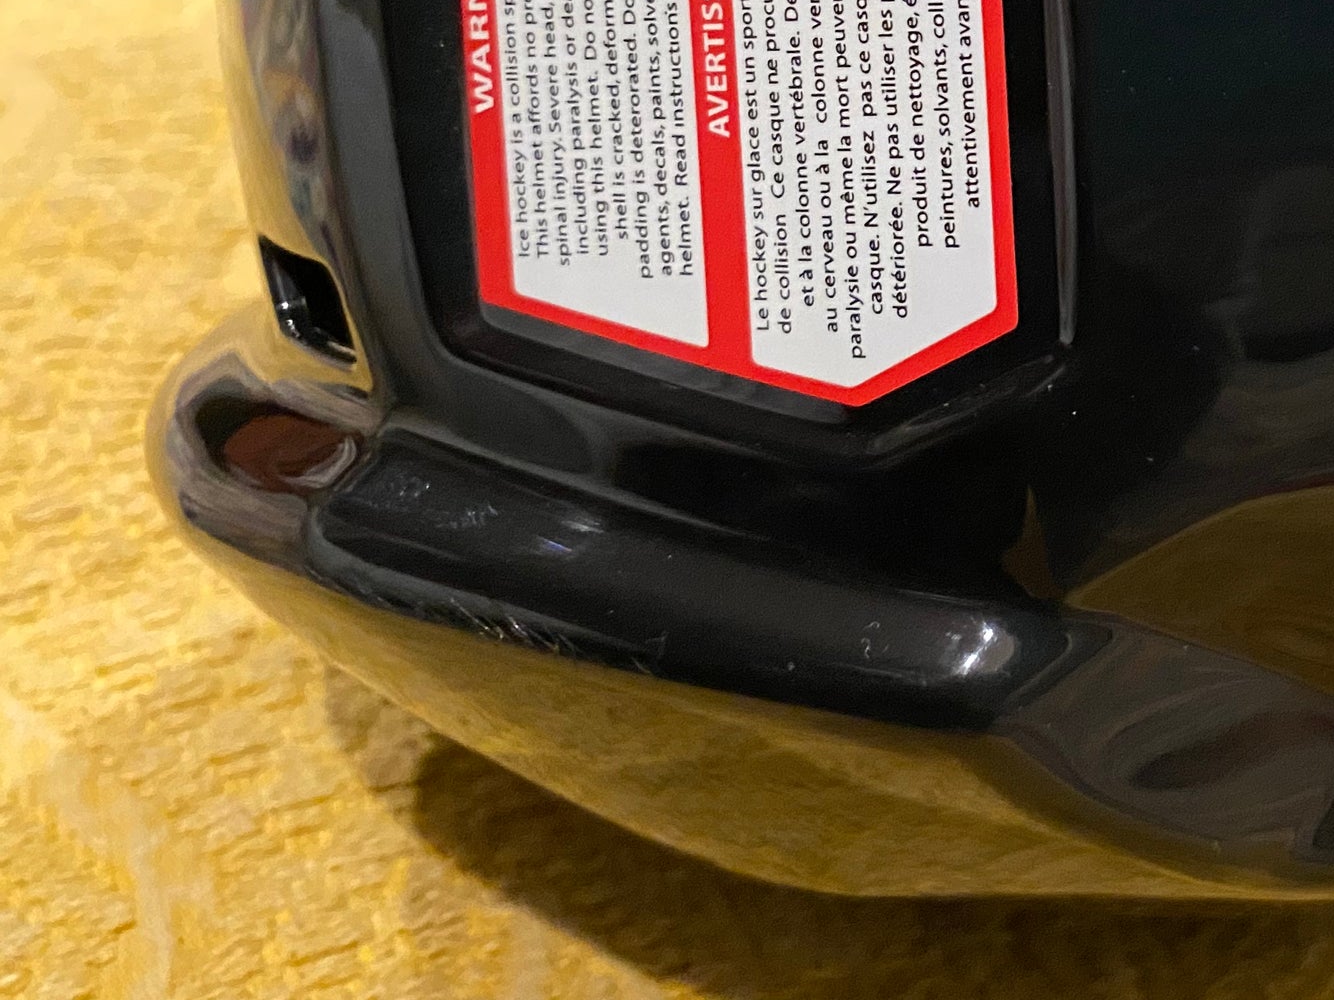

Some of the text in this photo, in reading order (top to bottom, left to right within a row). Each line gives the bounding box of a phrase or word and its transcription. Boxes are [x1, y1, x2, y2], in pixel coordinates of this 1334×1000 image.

[525, 32, 536, 58] no
[539, 2, 557, 58] head,
[584, 31, 597, 60] Do
[877, 9, 894, 38] les
[504, 22, 520, 106] collision
[648, 51, 667, 120] paints,
[664, 2, 685, 127] instructions
[744, 56, 756, 83] un
[785, 31, 806, 146] vertébrale.
[810, 37, 828, 124] colonne
[859, 50, 871, 75] ce
[880, 43, 898, 116] utiliser
[906, 12, 925, 127] nettoyage,
[933, 43, 951, 137] solvants,
[525, 64, 542, 135] affords
[548, 64, 562, 133] Severe
[564, 62, 586, 150] paralysis
[587, 71, 602, 149] helmet.
[605, 80, 624, 165] cracked,
[622, 33, 644, 163] deterorated.
[744, 89, 758, 120] est
[769, 91, 785, 166] casque
[835, 75, 851, 128] mort
[860, 80, 878, 117] pas
[958, 53, 980, 208] attentivement
[551, 138, 568, 200] injury.
[590, 156, 605, 194] this
[650, 125, 668, 196] decals,
[671, 134, 688, 186] Read
[746, 126, 766, 182] glace
[813, 140, 829, 156] la
[836, 135, 852, 152] la
[887, 123, 904, 159] pas
[909, 133, 925, 161] de
[513, 150, 528, 223] hockey
[531, 141, 547, 213] helmet
[572, 158, 589, 254] including
[752, 187, 764, 220] sur
[770, 172, 785, 199] Ce
[795, 152, 811, 239] colonne
[820, 181, 832, 209] ou
[840, 157, 856, 225] même
[860, 130, 879, 228] N'utilisez
[886, 166, 902, 195] Ne
[911, 166, 934, 247] produit
[939, 141, 960, 248] peintures,
[518, 229, 530, 257] Ice
[535, 218, 549, 258] This
[553, 207, 572, 266] spinal
[594, 200, 610, 256] using
[612, 193, 629, 239] shell
[634, 191, 654, 279] padding
[657, 200, 675, 276] agents,
[677, 196, 693, 276] helmet.
[845, 232, 858, 259] ou
[752, 225, 769, 301] hockey
[773, 214, 790, 301] collision
[797, 245, 813, 262] la
[821, 215, 837, 299] cerveau
[869, 234, 885, 315] casque.
[888, 202, 908, 319] détériorée.
[756, 307, 769, 331] Le
[777, 307, 792, 334] de
[801, 286, 815, 307] et
[826, 308, 838, 333] au
[844, 265, 867, 359] paralysie
